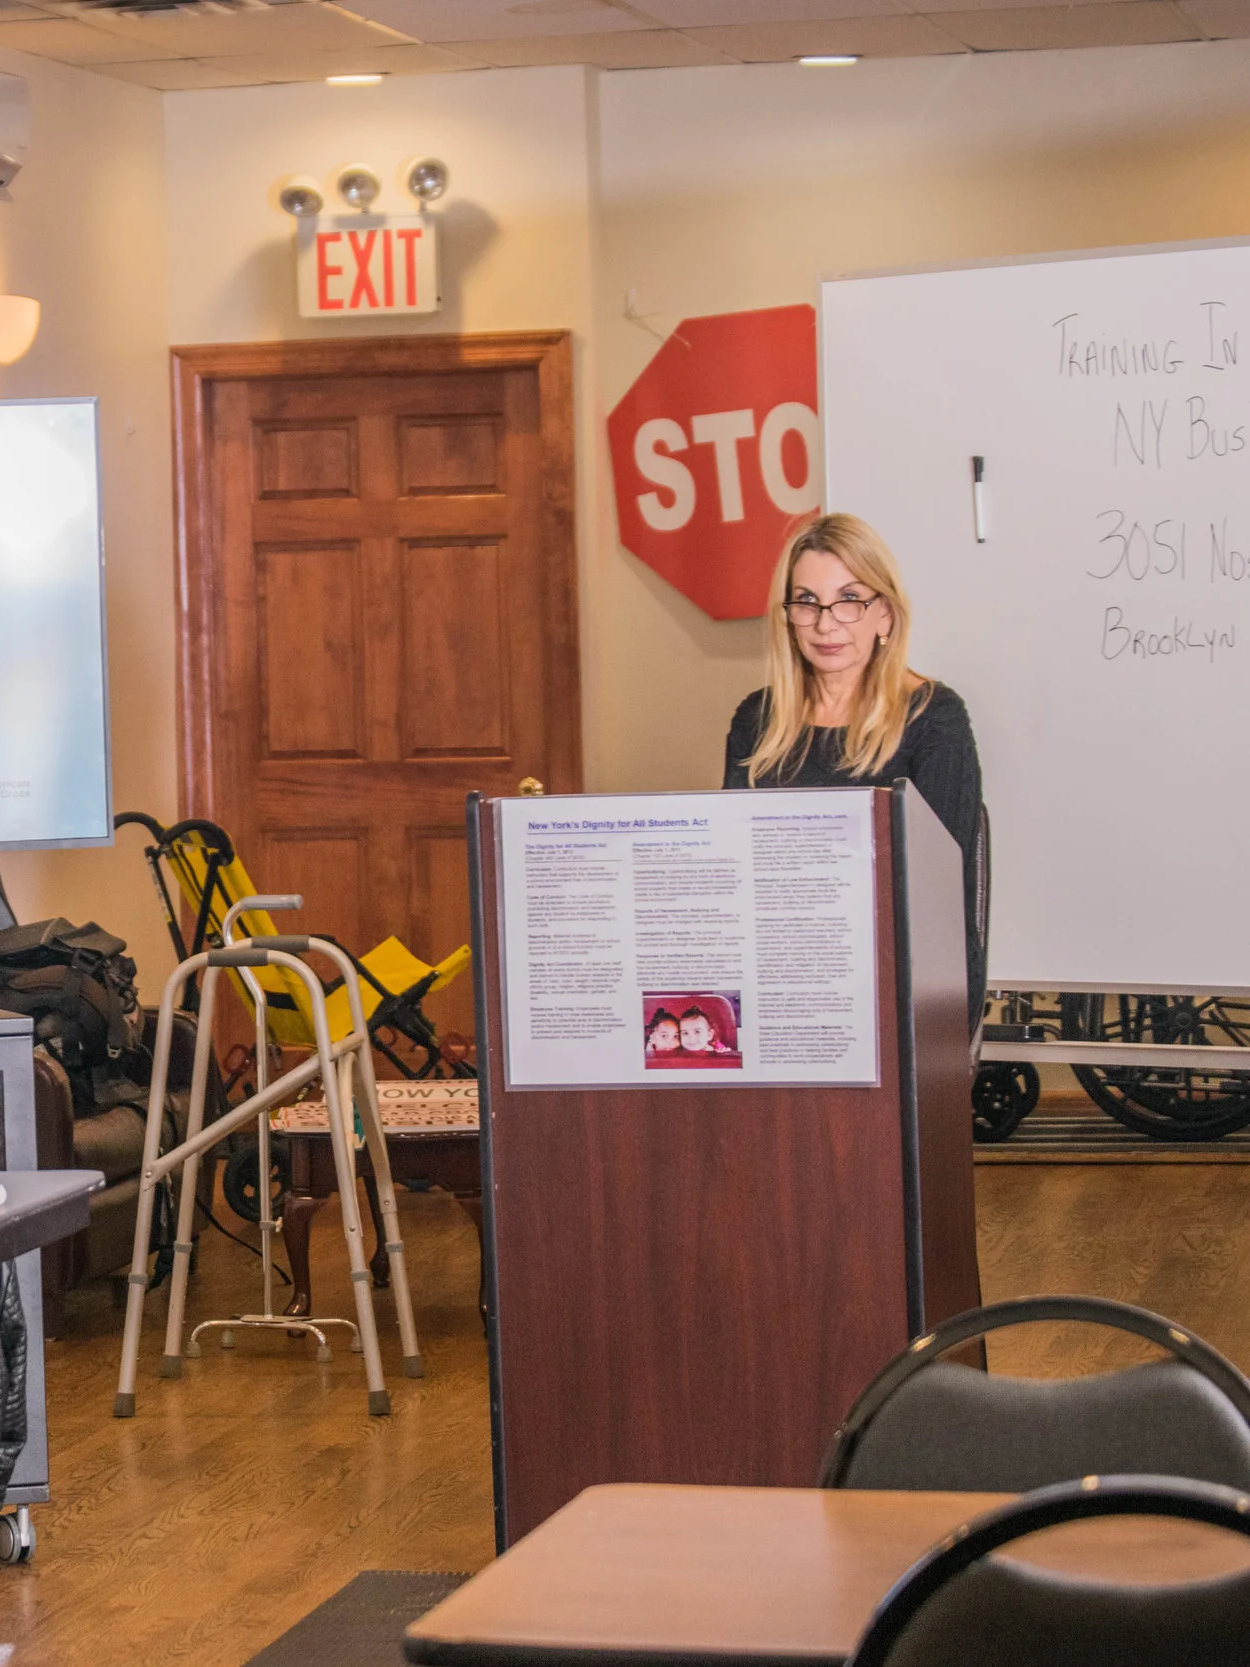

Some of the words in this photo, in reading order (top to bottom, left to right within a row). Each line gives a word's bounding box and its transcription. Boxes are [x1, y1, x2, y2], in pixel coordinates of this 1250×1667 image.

[316, 228, 422, 310] EXIT
[633, 401, 820, 532] STO
[1115, 398, 1168, 468] NY
[1086, 509, 1185, 580] 3051
[528, 821, 548, 830] New
[551, 821, 580, 830] York's
[582, 820, 615, 830] Dignity
[617, 819, 630, 828] for
[633, 819, 646, 827] All
[648, 818, 689, 828] Students
[692, 818, 709, 826] Act
[377, 1087, 434, 1099] OW
